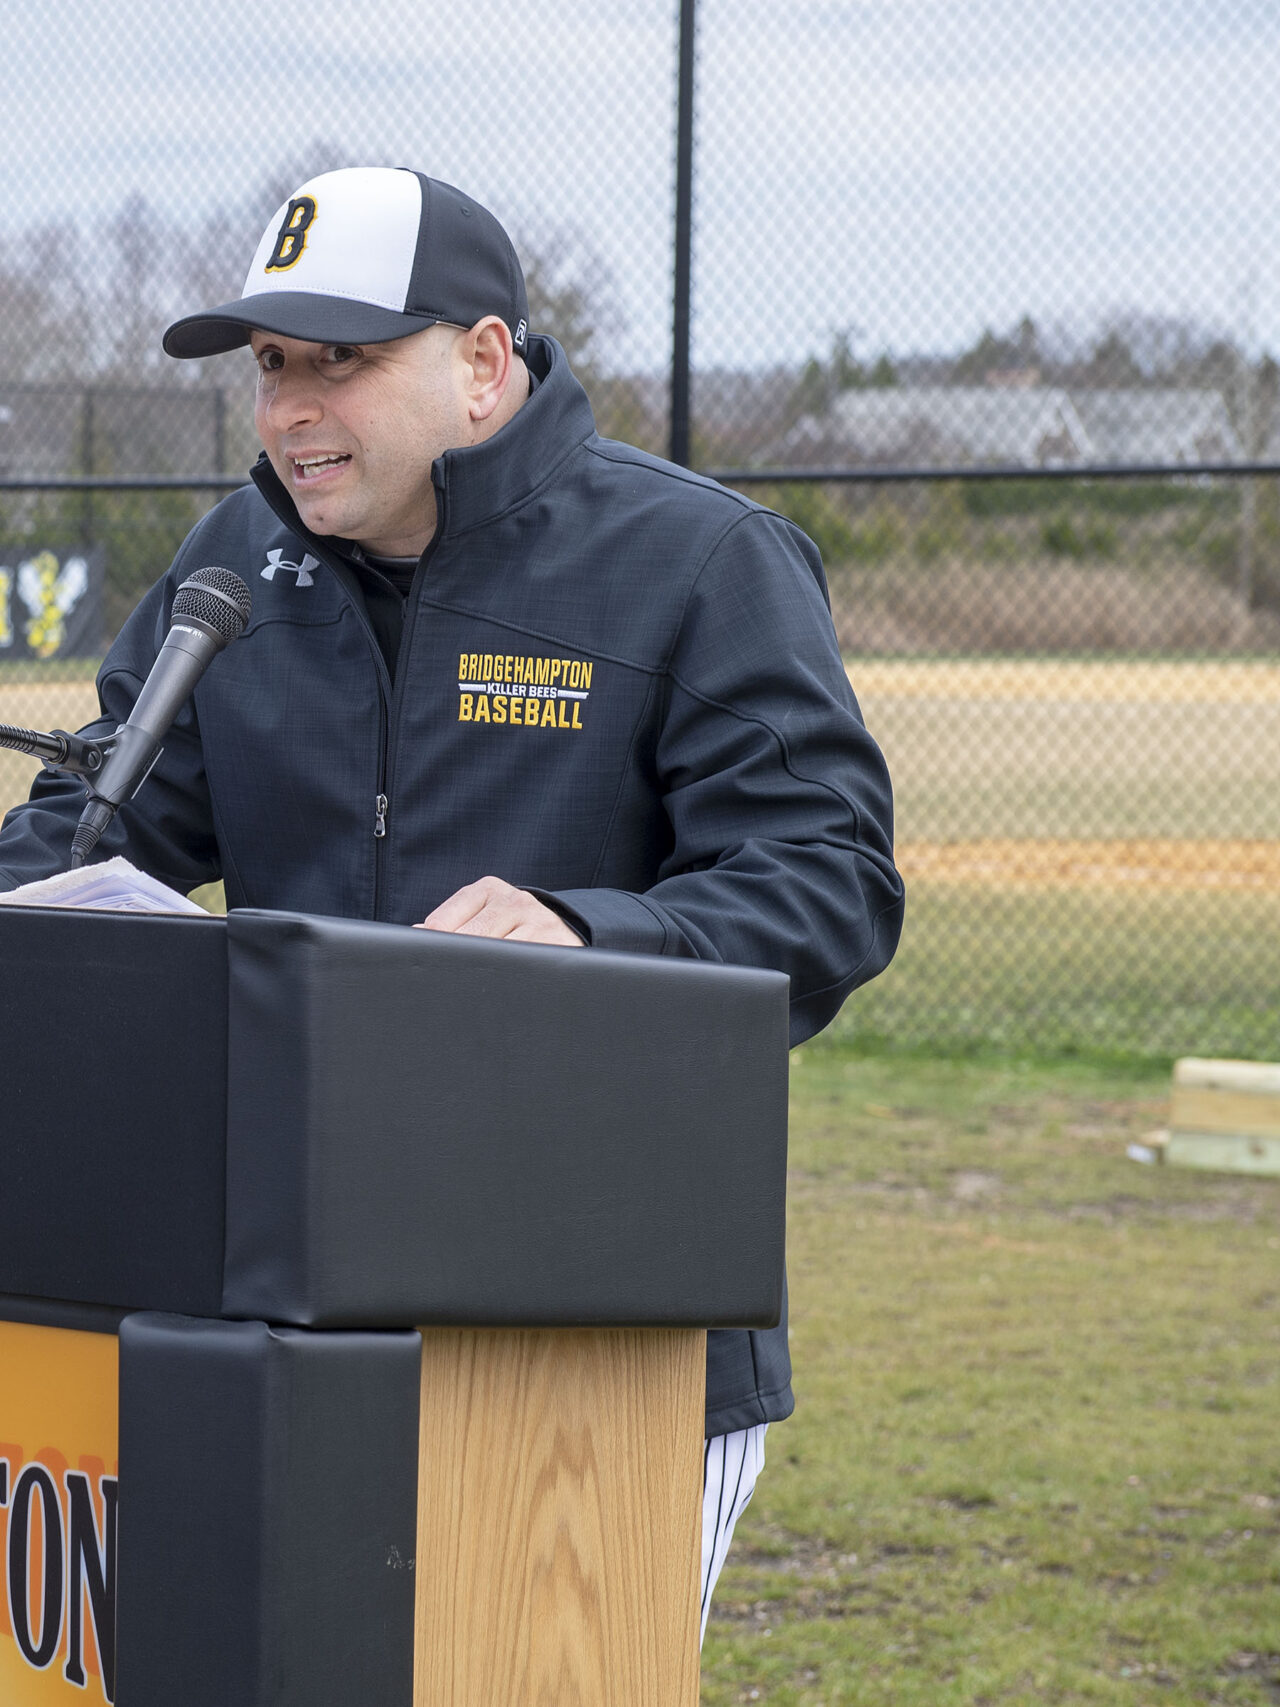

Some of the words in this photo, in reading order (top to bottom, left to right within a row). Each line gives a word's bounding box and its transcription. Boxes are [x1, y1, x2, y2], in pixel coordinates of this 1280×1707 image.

[264, 194, 319, 274] B
[458, 653, 593, 689] BRIDGEHAMPTON
[486, 682, 526, 698] KILLER
[528, 685, 558, 699] BEES
[458, 693, 583, 730] BASEBALL
